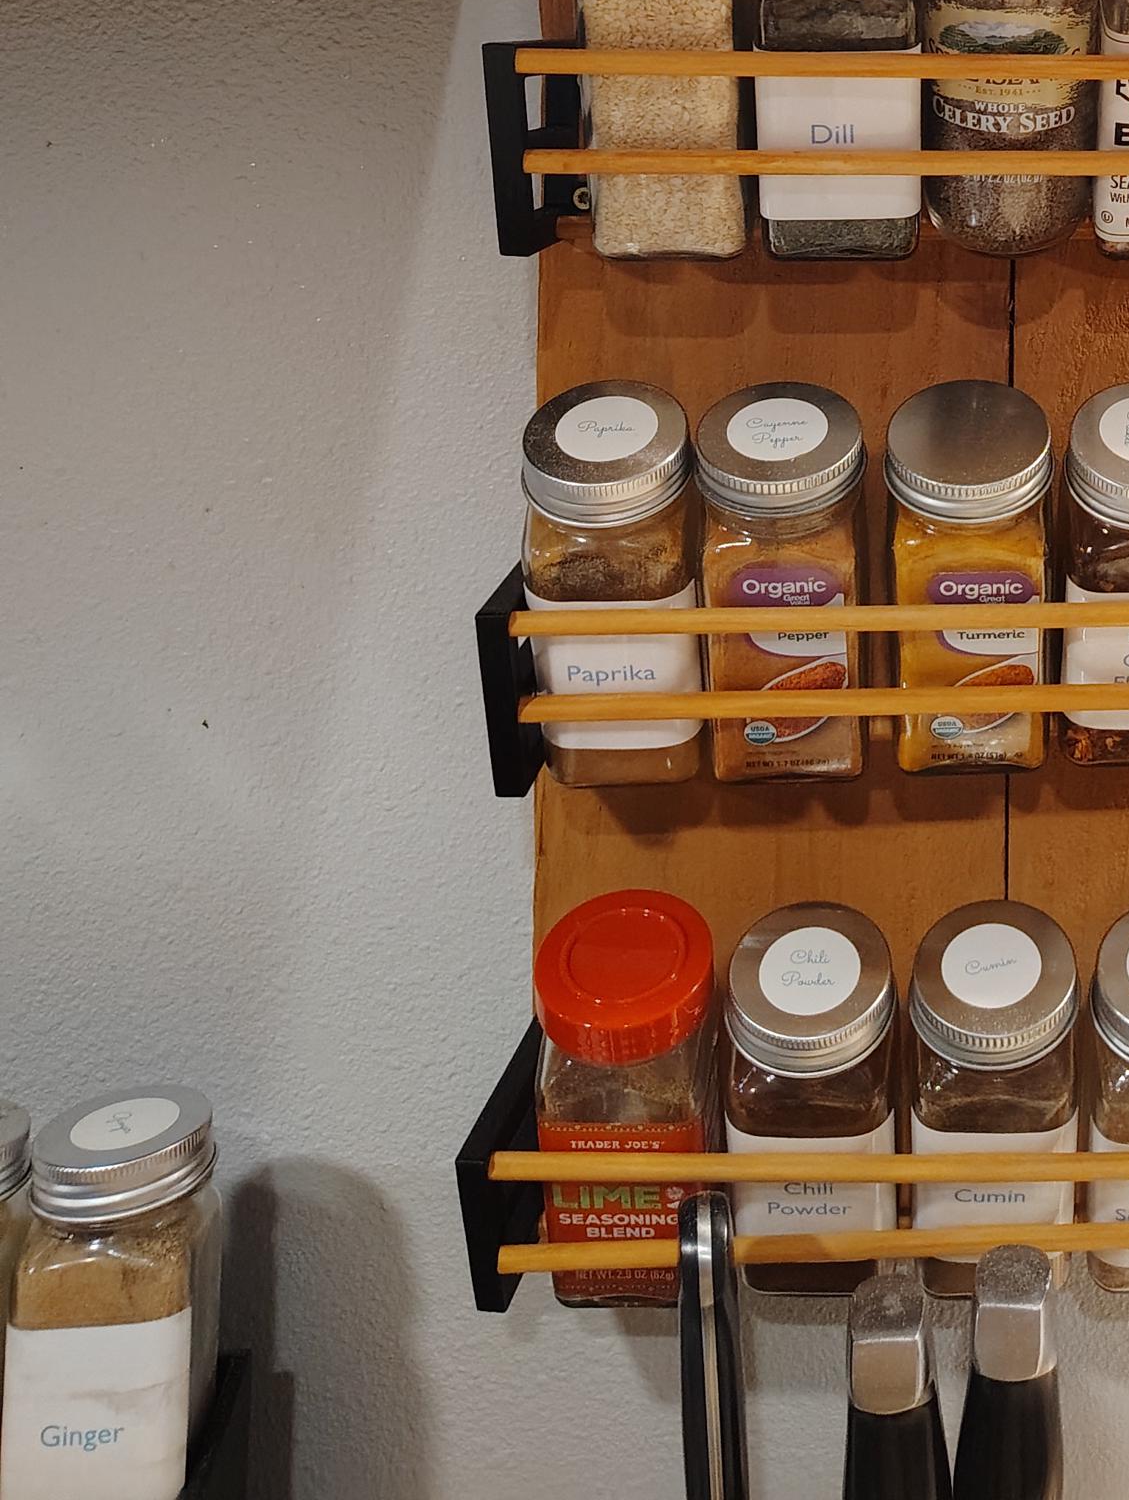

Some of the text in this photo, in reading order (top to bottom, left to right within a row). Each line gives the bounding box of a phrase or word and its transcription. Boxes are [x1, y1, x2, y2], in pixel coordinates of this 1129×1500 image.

[975, 100, 1026, 114] WHOLE
[932, 95, 1076, 135] CELERY SEED
[810, 124, 855, 145] Dill
[577, 419, 636, 438] Paprika
[742, 577, 827, 598] Organic
[939, 580, 1024, 599] Organic
[778, 631, 830, 642] Pepper
[957, 630, 1025, 640] Turmeric
[567, 665, 656, 687] Paprika
[570, 1140, 661, 1150] TRADER JOE'S
[551, 1183, 662, 1210] LIME
[783, 1182, 833, 1196] Chili
[954, 1189, 1026, 1204] Cumin
[767, 1202, 853, 1216] Powder
[559, 1213, 678, 1225] SEASONING
[586, 1227, 655, 1238] BLEND
[40, 1424, 125, 1452] Ginger
